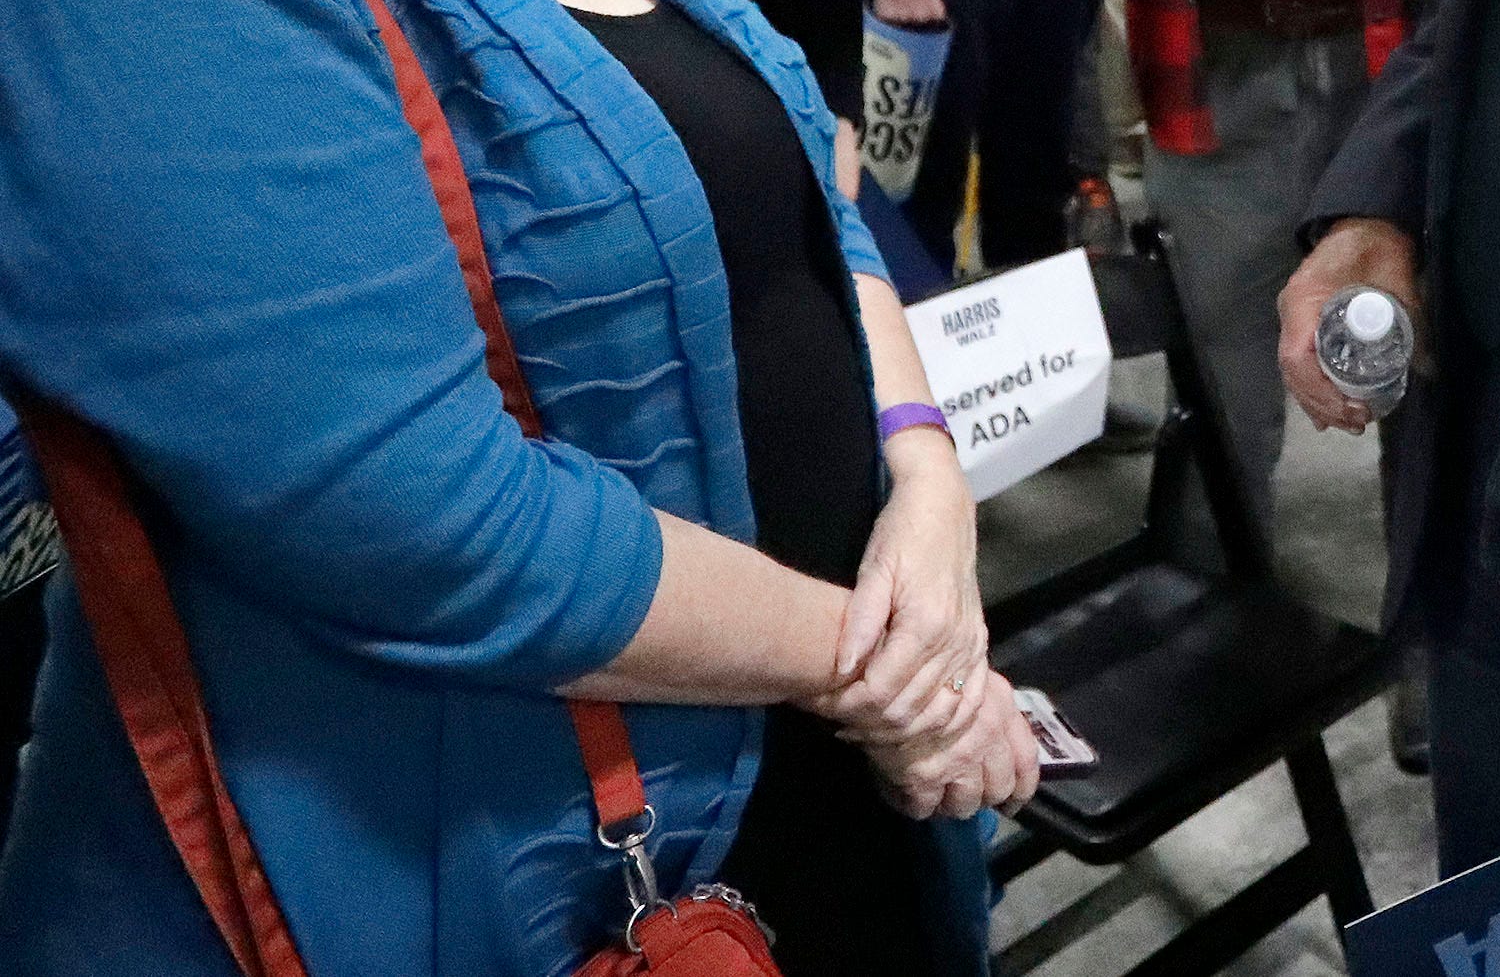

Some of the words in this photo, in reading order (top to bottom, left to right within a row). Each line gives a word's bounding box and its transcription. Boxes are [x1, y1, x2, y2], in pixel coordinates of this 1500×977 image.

[942, 297, 1001, 336] HARRIS
[956, 323, 996, 347] WALZ
[941, 360, 1033, 416] served
[1039, 349, 1076, 378] for
[970, 406, 1032, 449] ADA
